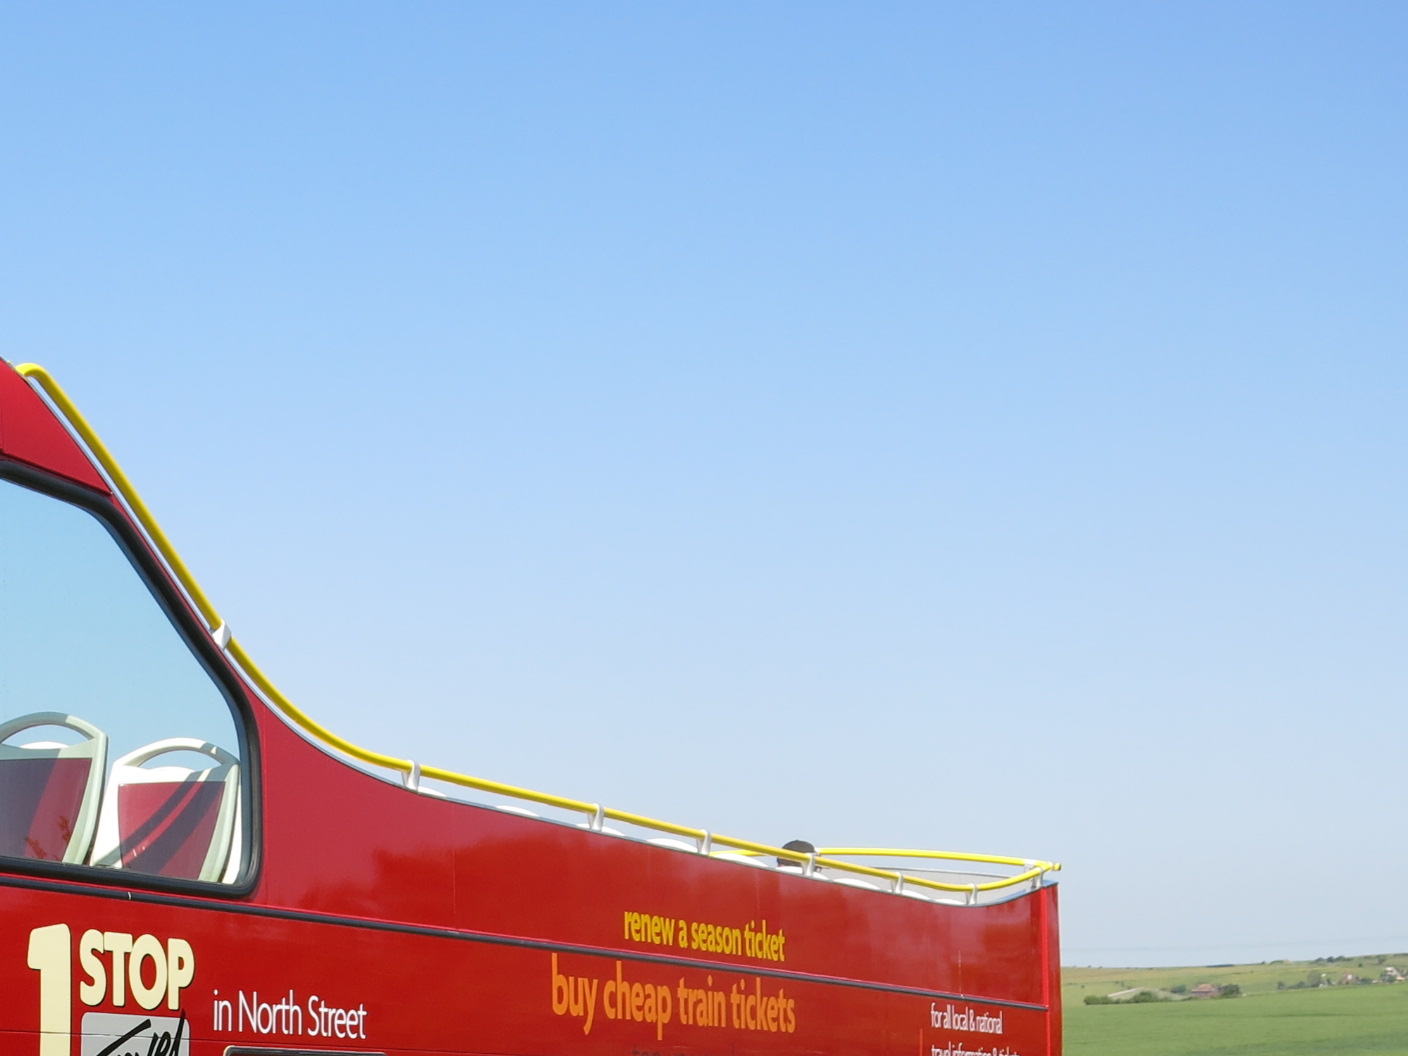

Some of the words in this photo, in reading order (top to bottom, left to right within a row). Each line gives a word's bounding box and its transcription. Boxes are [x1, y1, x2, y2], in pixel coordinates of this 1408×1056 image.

[624, 911, 675, 946] renew
[679, 920, 688, 948] a
[691, 922, 742, 956] season
[745, 919, 785, 961] ticket
[79, 928, 195, 1011] STOP
[213, 989, 231, 1032] in
[238, 989, 302, 1036] North
[307, 994, 367, 1040] Street
[551, 952, 598, 1036] buy
[603, 960, 672, 1041] cheap
[677, 974, 726, 1027] train
[730, 976, 796, 1033] tickets
[930, 1002, 942, 1028] for
[943, 1004, 951, 1029] all
[952, 1004, 968, 1031] local
[969, 1008, 975, 1031] &
[976, 1010, 1003, 1034] national
